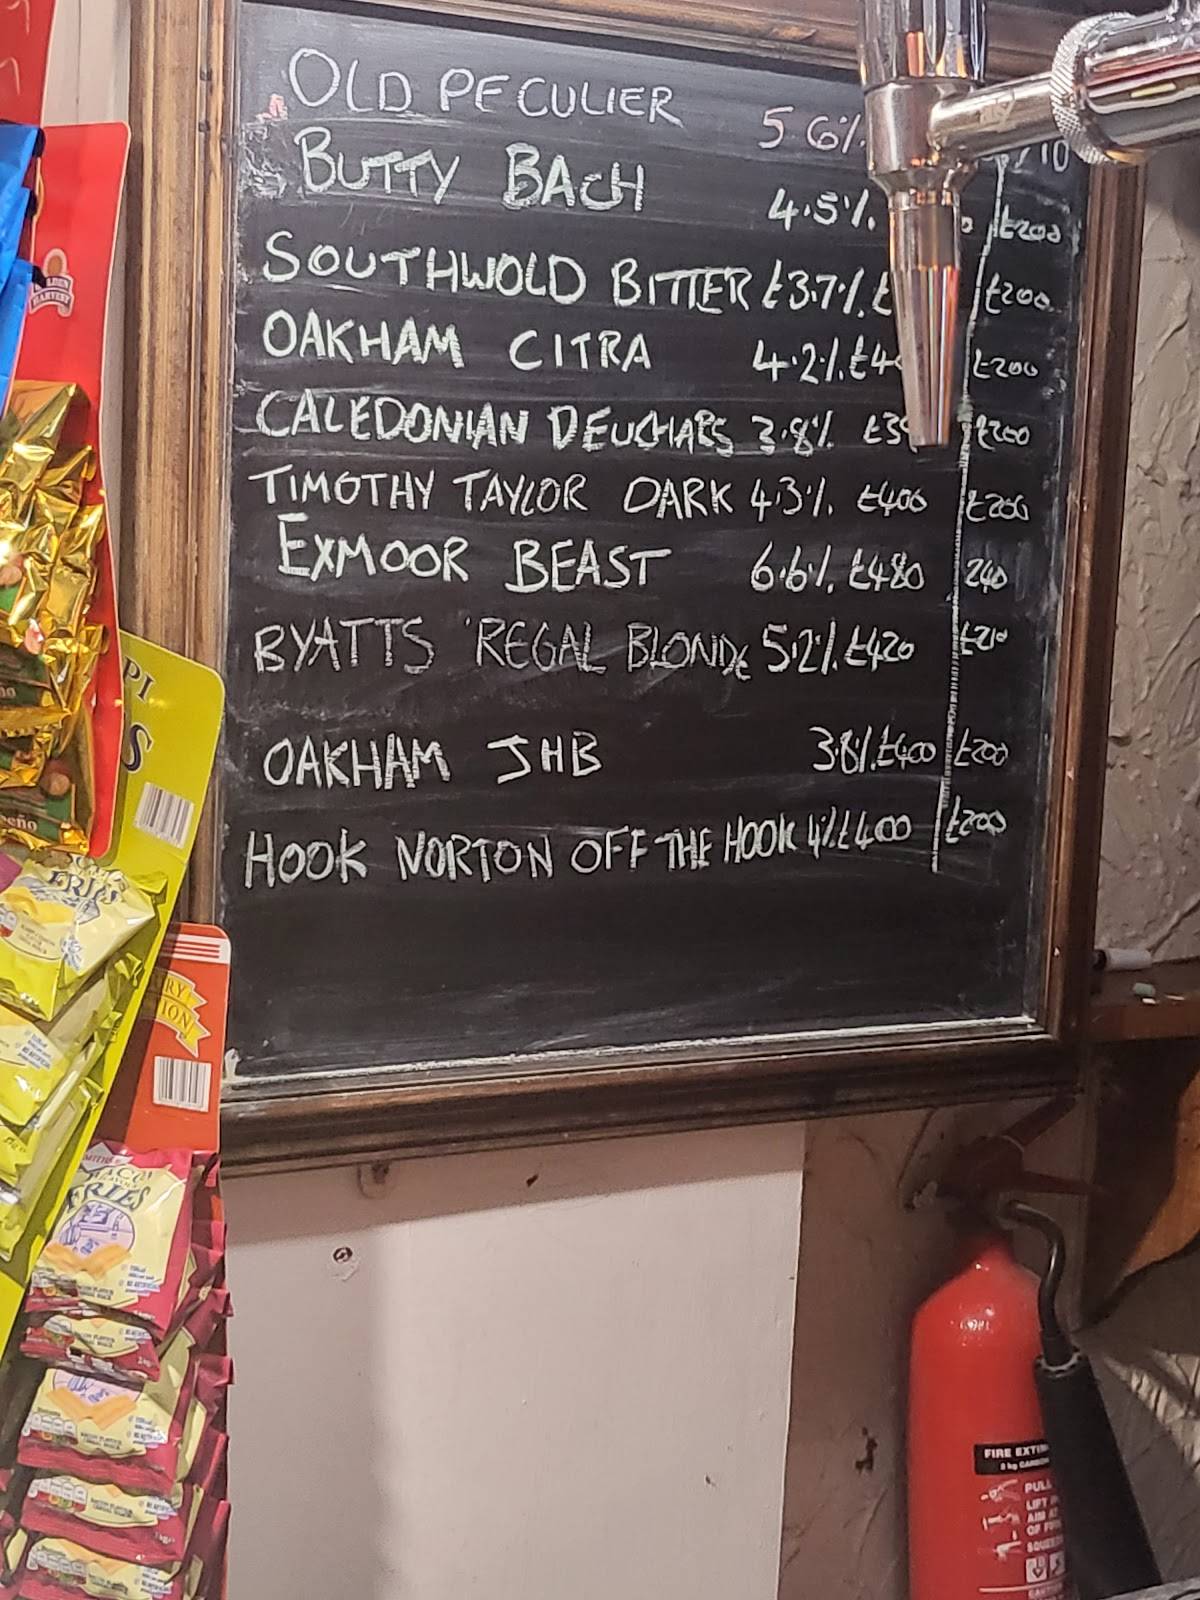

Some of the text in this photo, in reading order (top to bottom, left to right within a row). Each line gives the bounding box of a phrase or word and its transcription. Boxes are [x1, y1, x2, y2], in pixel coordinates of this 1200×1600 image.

[288, 47, 413, 113] OLD
[439, 67, 685, 128] PECULIER
[293, 126, 460, 204] BUTTY
[503, 142, 645, 212] BACH
[262, 230, 587, 305] SOUTHWOLD
[611, 257, 752, 314] BITTER
[262, 309, 465, 368] OAKHAM
[508, 329, 652, 372] CITRA
[972, 348, 1038, 379] £200
[255, 388, 529, 450] CALEDONIAN
[248, 464, 435, 511] TIMOTHY
[453, 469, 588, 514] TAYLOR
[624, 475, 734, 520] DARK
[278, 512, 469, 582] EXMOOR
[505, 539, 672, 593] BEAST
[254, 616, 435, 674] BYATTS
[844, 624, 915, 671] £420
[263, 733, 450, 789] OAKHAM
[488, 731, 602, 785] JHB
[244, 828, 368, 889] HOOK
[396, 829, 553, 882] NORTON
[571, 827, 647, 875] OFF
[654, 827, 713, 872] THE
[724, 813, 797, 864] HOOK
[984, 1447, 1012, 1459] FIRE
